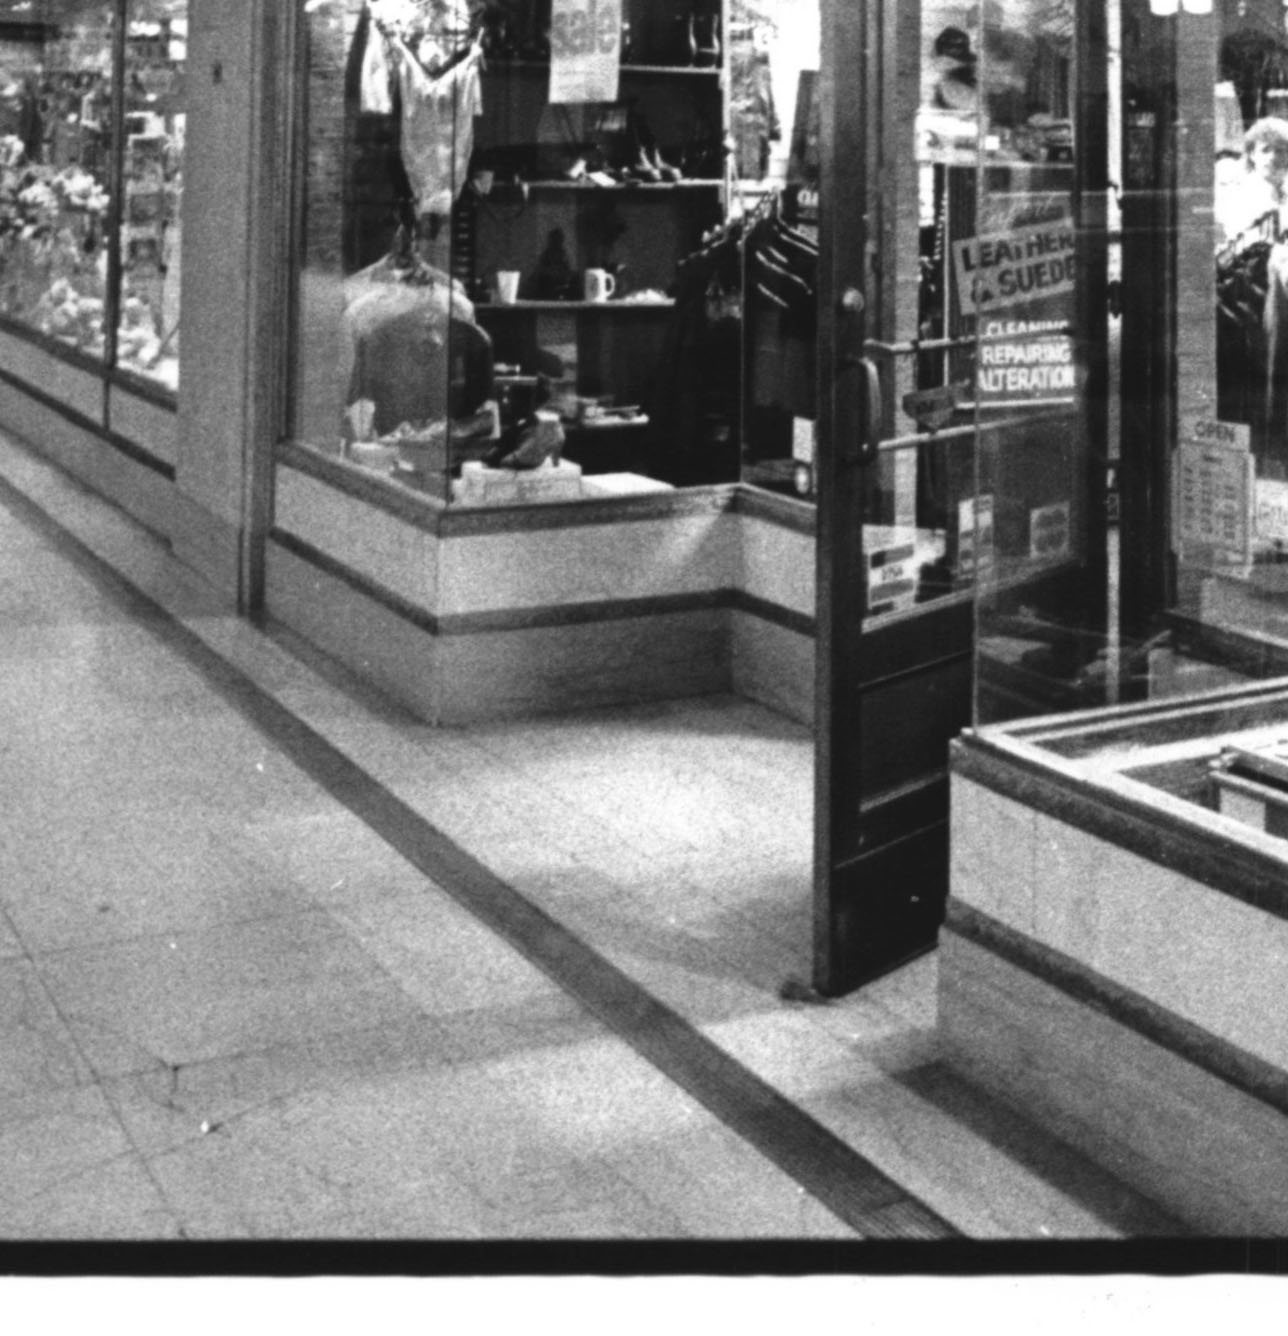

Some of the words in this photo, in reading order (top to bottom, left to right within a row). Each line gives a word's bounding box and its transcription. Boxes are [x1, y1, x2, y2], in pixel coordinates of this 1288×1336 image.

[997, 254, 1074, 296] SUEDE
[981, 341, 1073, 365] REPAIRING
[1194, 420, 1237, 444] OPEN
